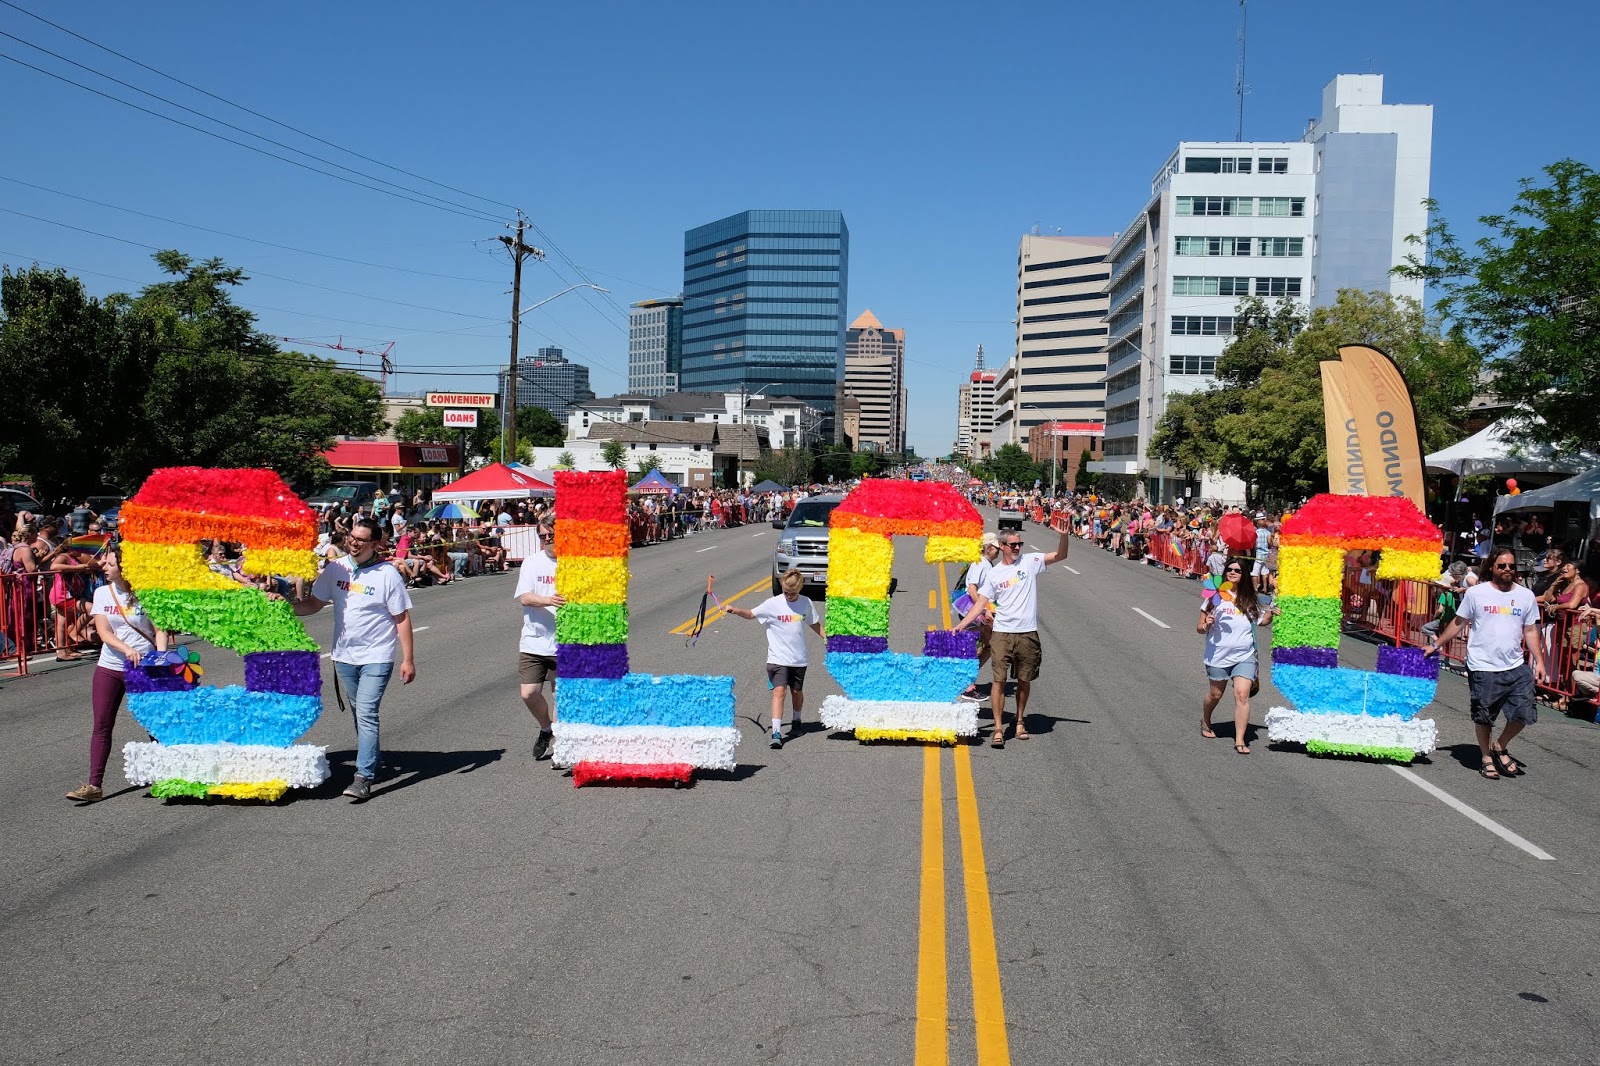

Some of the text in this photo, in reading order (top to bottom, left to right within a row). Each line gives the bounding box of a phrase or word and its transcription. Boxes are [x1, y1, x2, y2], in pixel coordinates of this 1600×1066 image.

[430, 395, 491, 405] CONVENIENT
[445, 413, 475, 423] LOANS
[423, 449, 447, 461] LOANS
